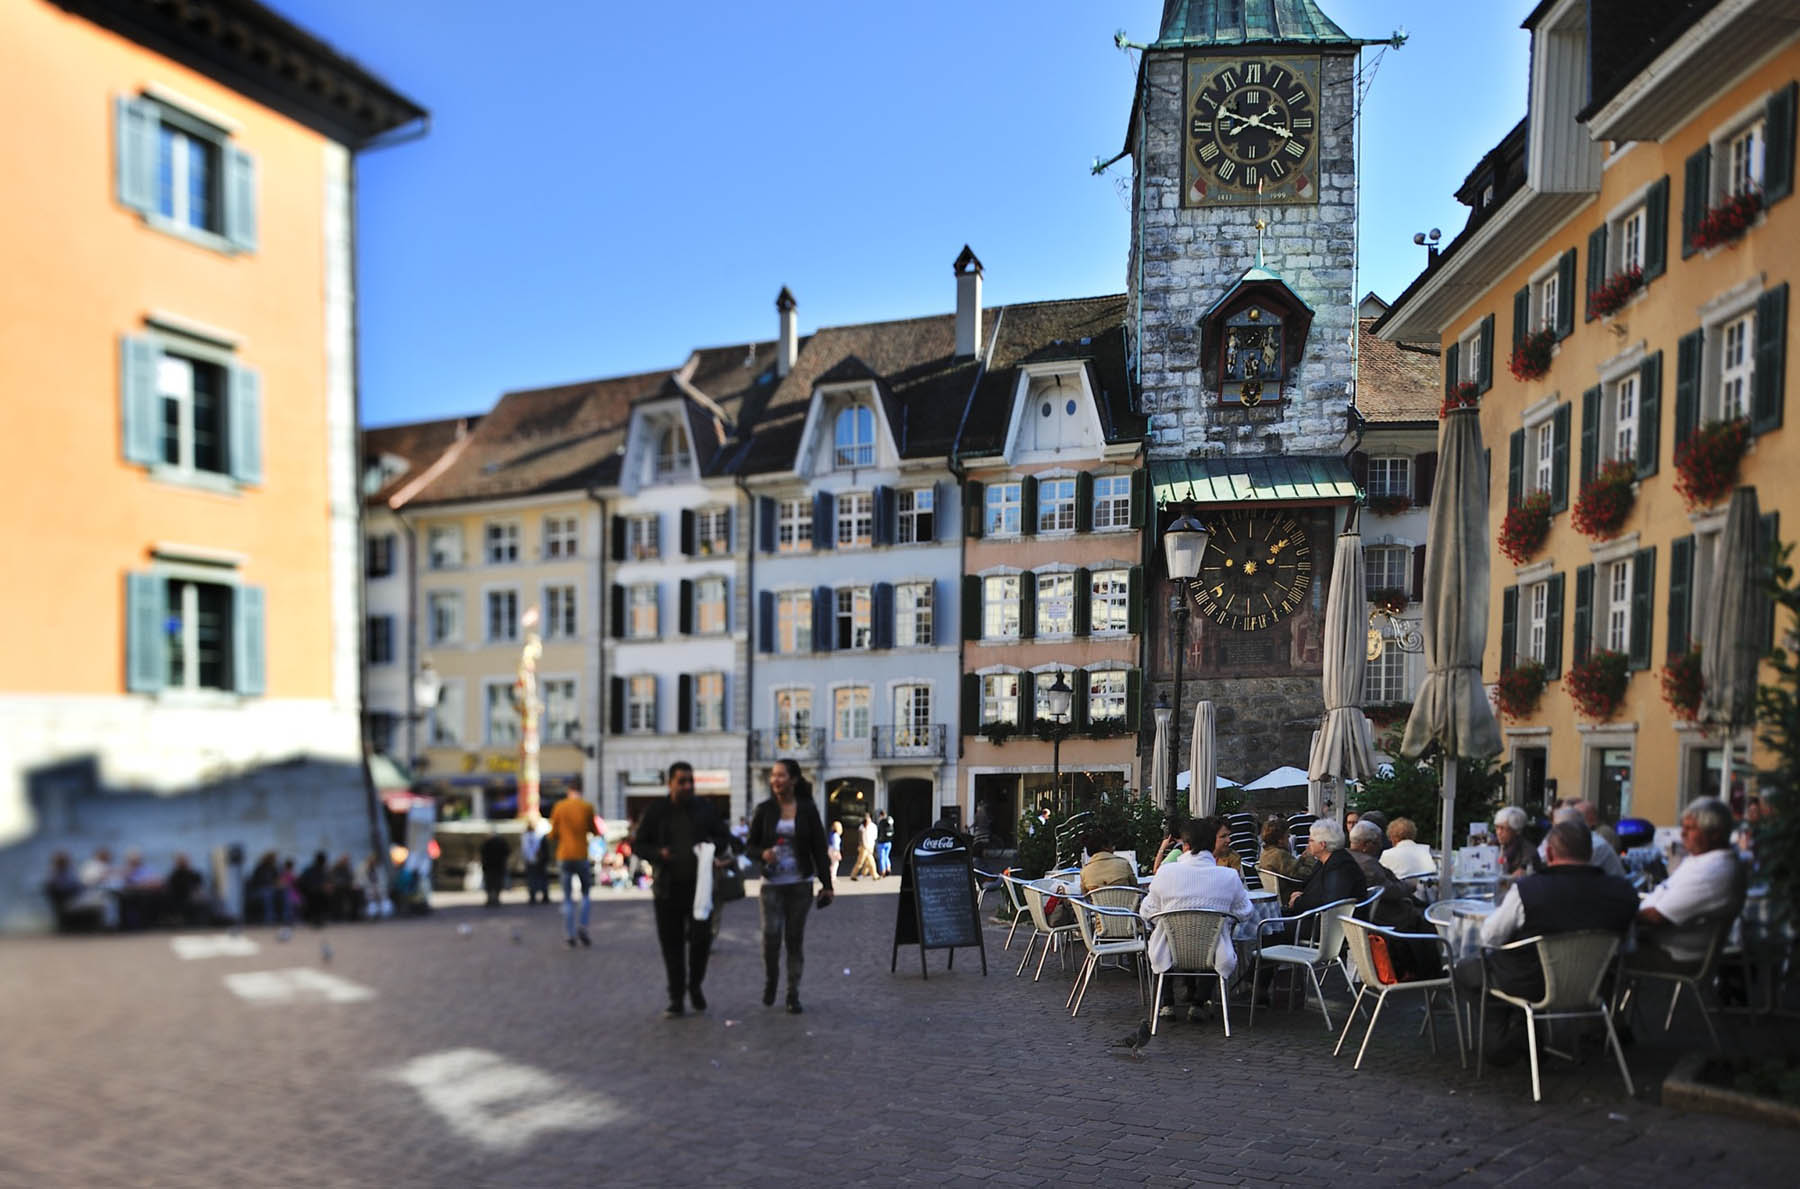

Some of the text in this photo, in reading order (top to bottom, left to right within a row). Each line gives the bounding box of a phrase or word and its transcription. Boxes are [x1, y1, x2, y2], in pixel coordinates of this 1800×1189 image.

[1221, 71, 1237, 93] XI
[1245, 63, 1261, 83] XII
[1272, 71, 1284, 88] I
[1202, 92, 1218, 110] X
[1287, 90, 1305, 105] II
